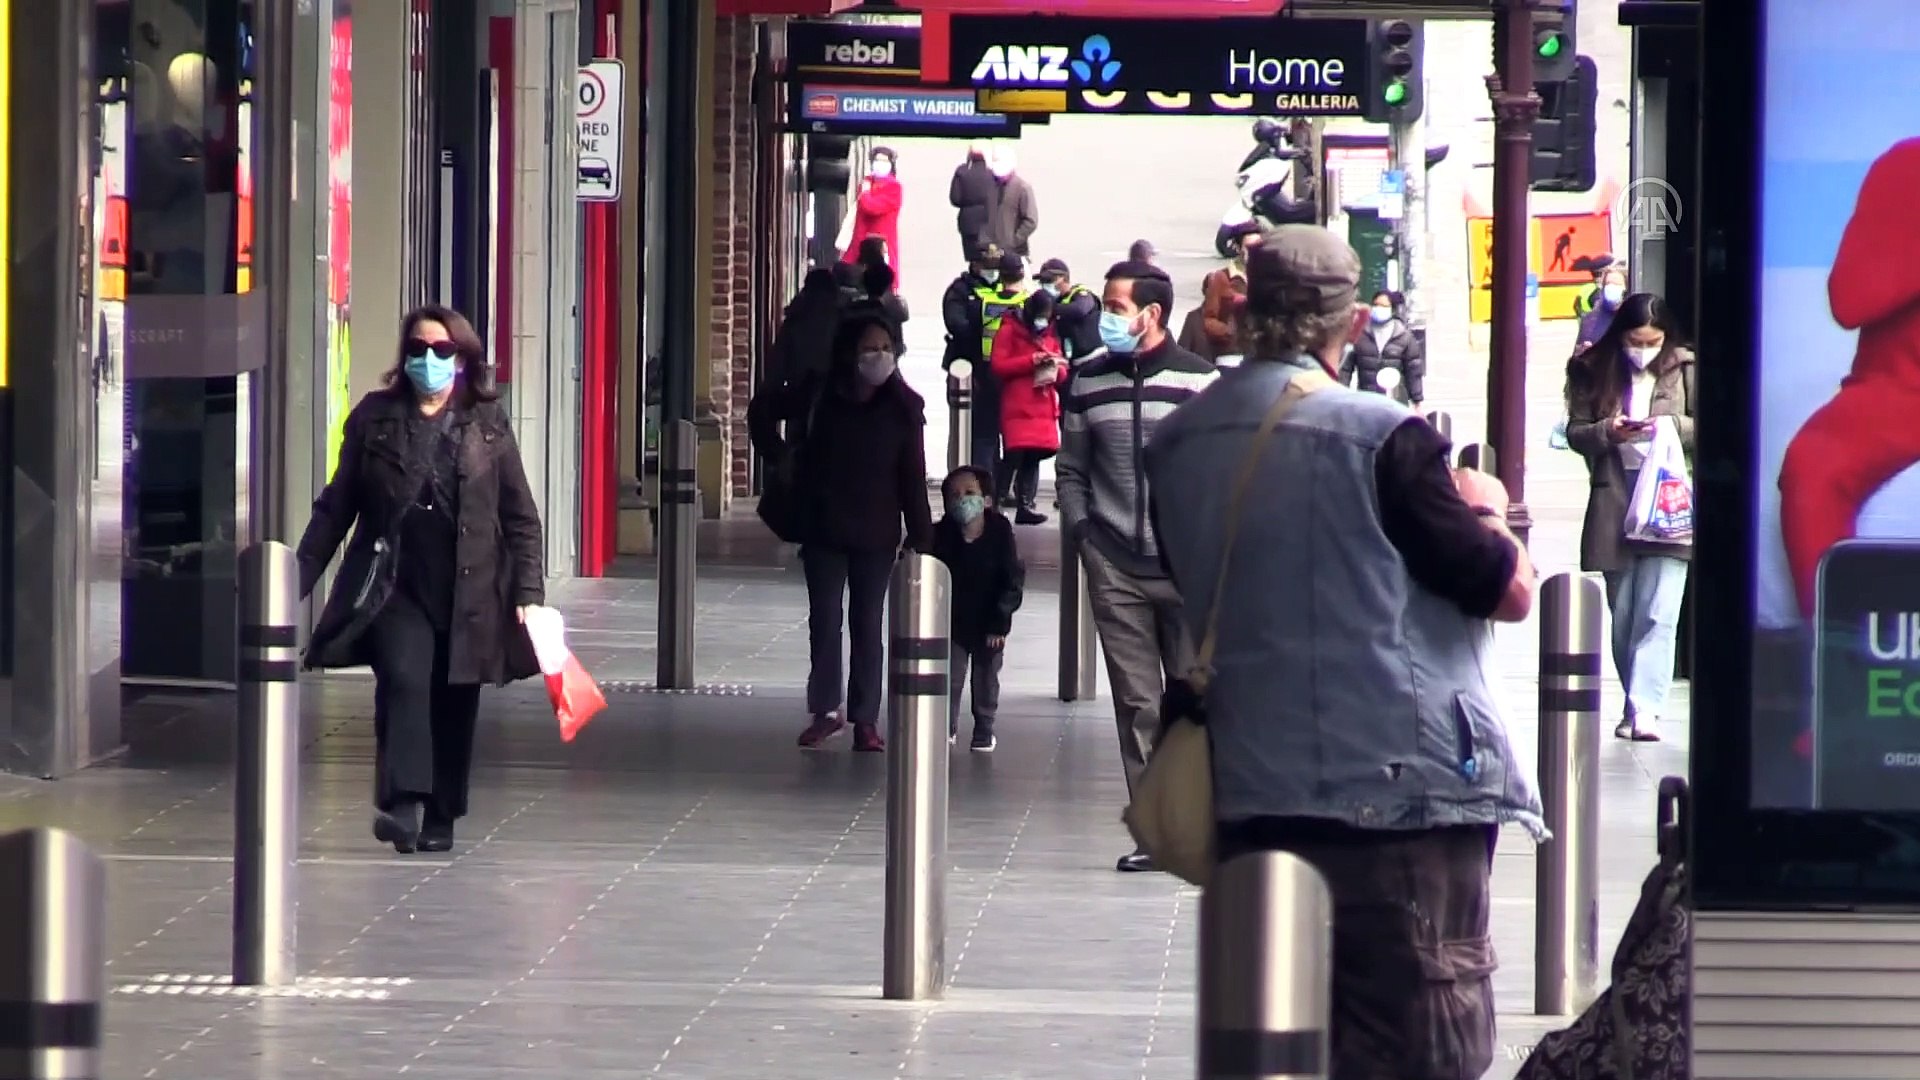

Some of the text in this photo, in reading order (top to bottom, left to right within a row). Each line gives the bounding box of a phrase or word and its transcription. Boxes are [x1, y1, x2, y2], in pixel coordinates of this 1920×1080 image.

[825, 40, 894, 63] rebel
[970, 45, 1069, 81] ANZ
[1230, 49, 1344, 85] Home
[843, 97, 906, 113] CHEMIST
[1276, 95, 1360, 109] GALLERIA
